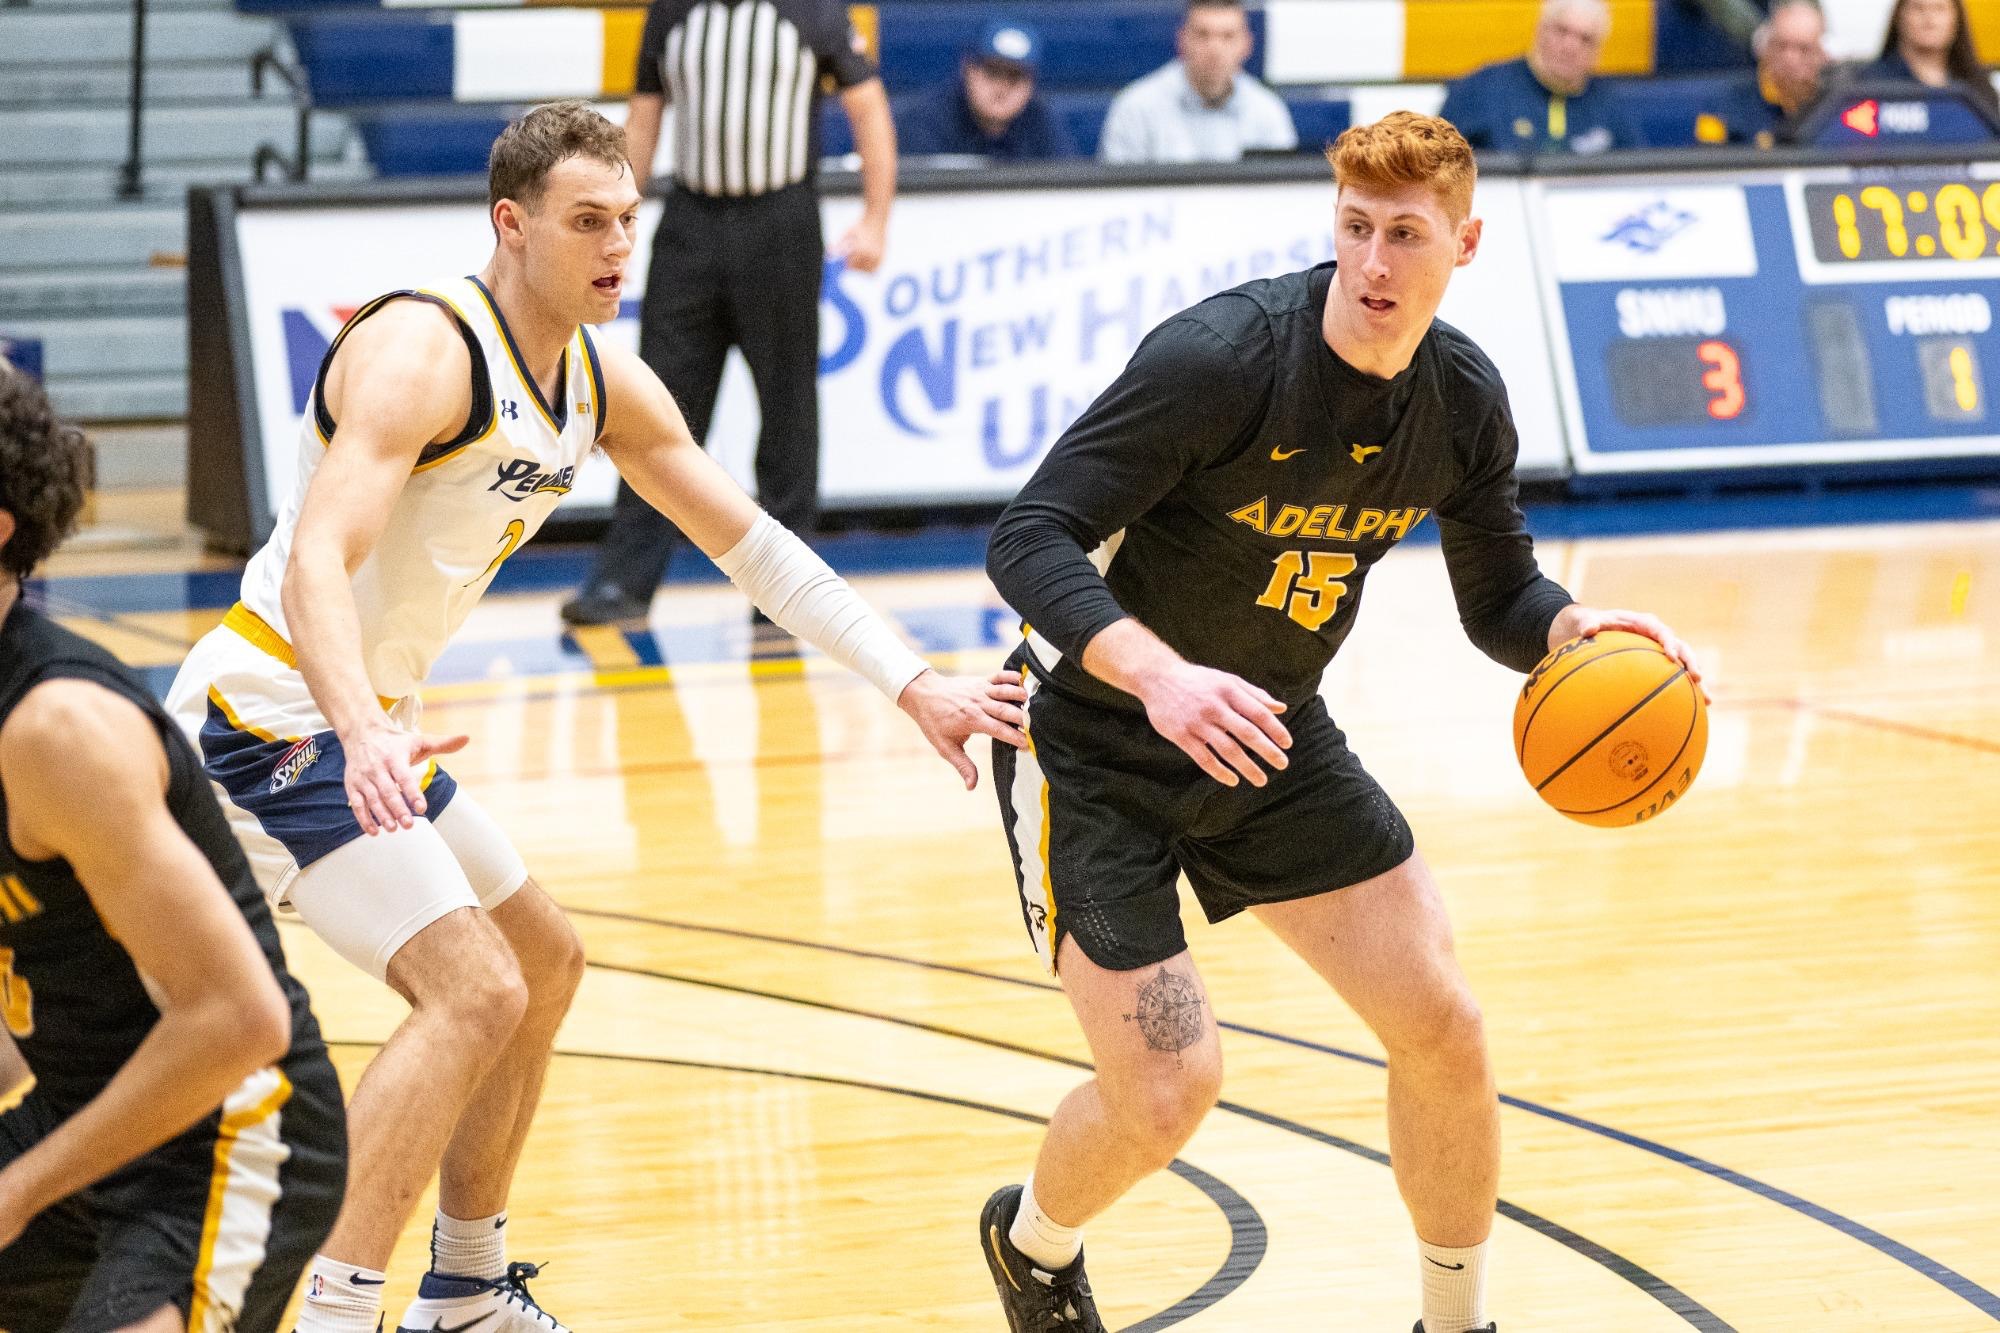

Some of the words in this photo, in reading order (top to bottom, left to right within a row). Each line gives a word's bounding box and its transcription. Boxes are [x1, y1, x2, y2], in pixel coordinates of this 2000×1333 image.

[878, 308, 1056, 438] NEW
[1078, 232, 1337, 364] HAMPS
[1696, 339, 1746, 419] 3
[1949, 346, 1978, 412] 1
[1255, 550, 1358, 632] 15
[270, 738, 317, 794] SNHU
